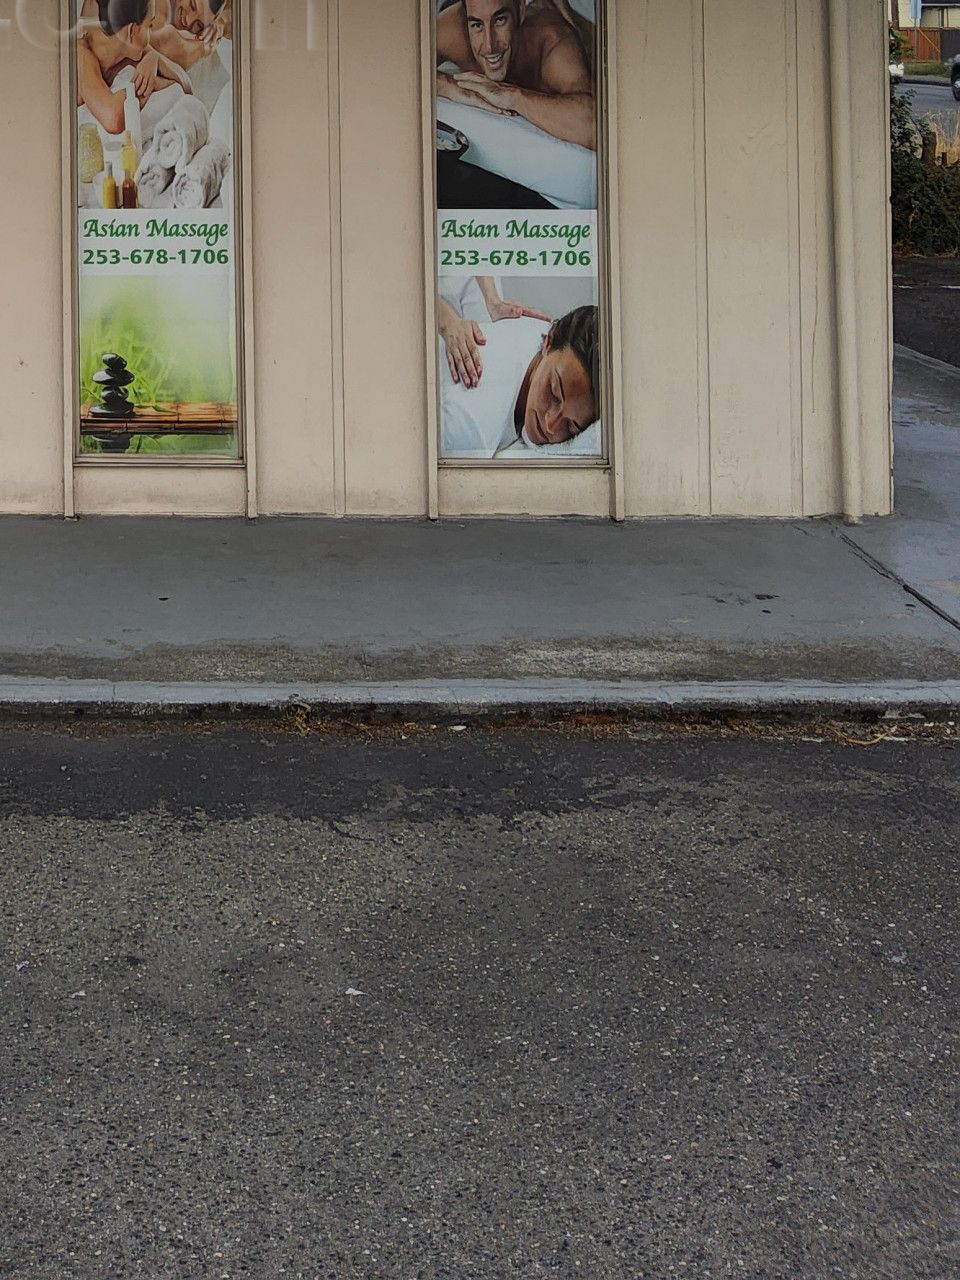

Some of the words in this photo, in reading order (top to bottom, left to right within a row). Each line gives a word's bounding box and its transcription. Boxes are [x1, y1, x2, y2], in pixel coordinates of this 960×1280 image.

[83, 218, 140, 238] Asian
[145, 218, 229, 247] Massage
[441, 219, 500, 238] Asian
[505, 219, 591, 248] Massage
[83, 248, 229, 265] 253-678-1706
[441, 250, 591, 266] 253-678-1706
